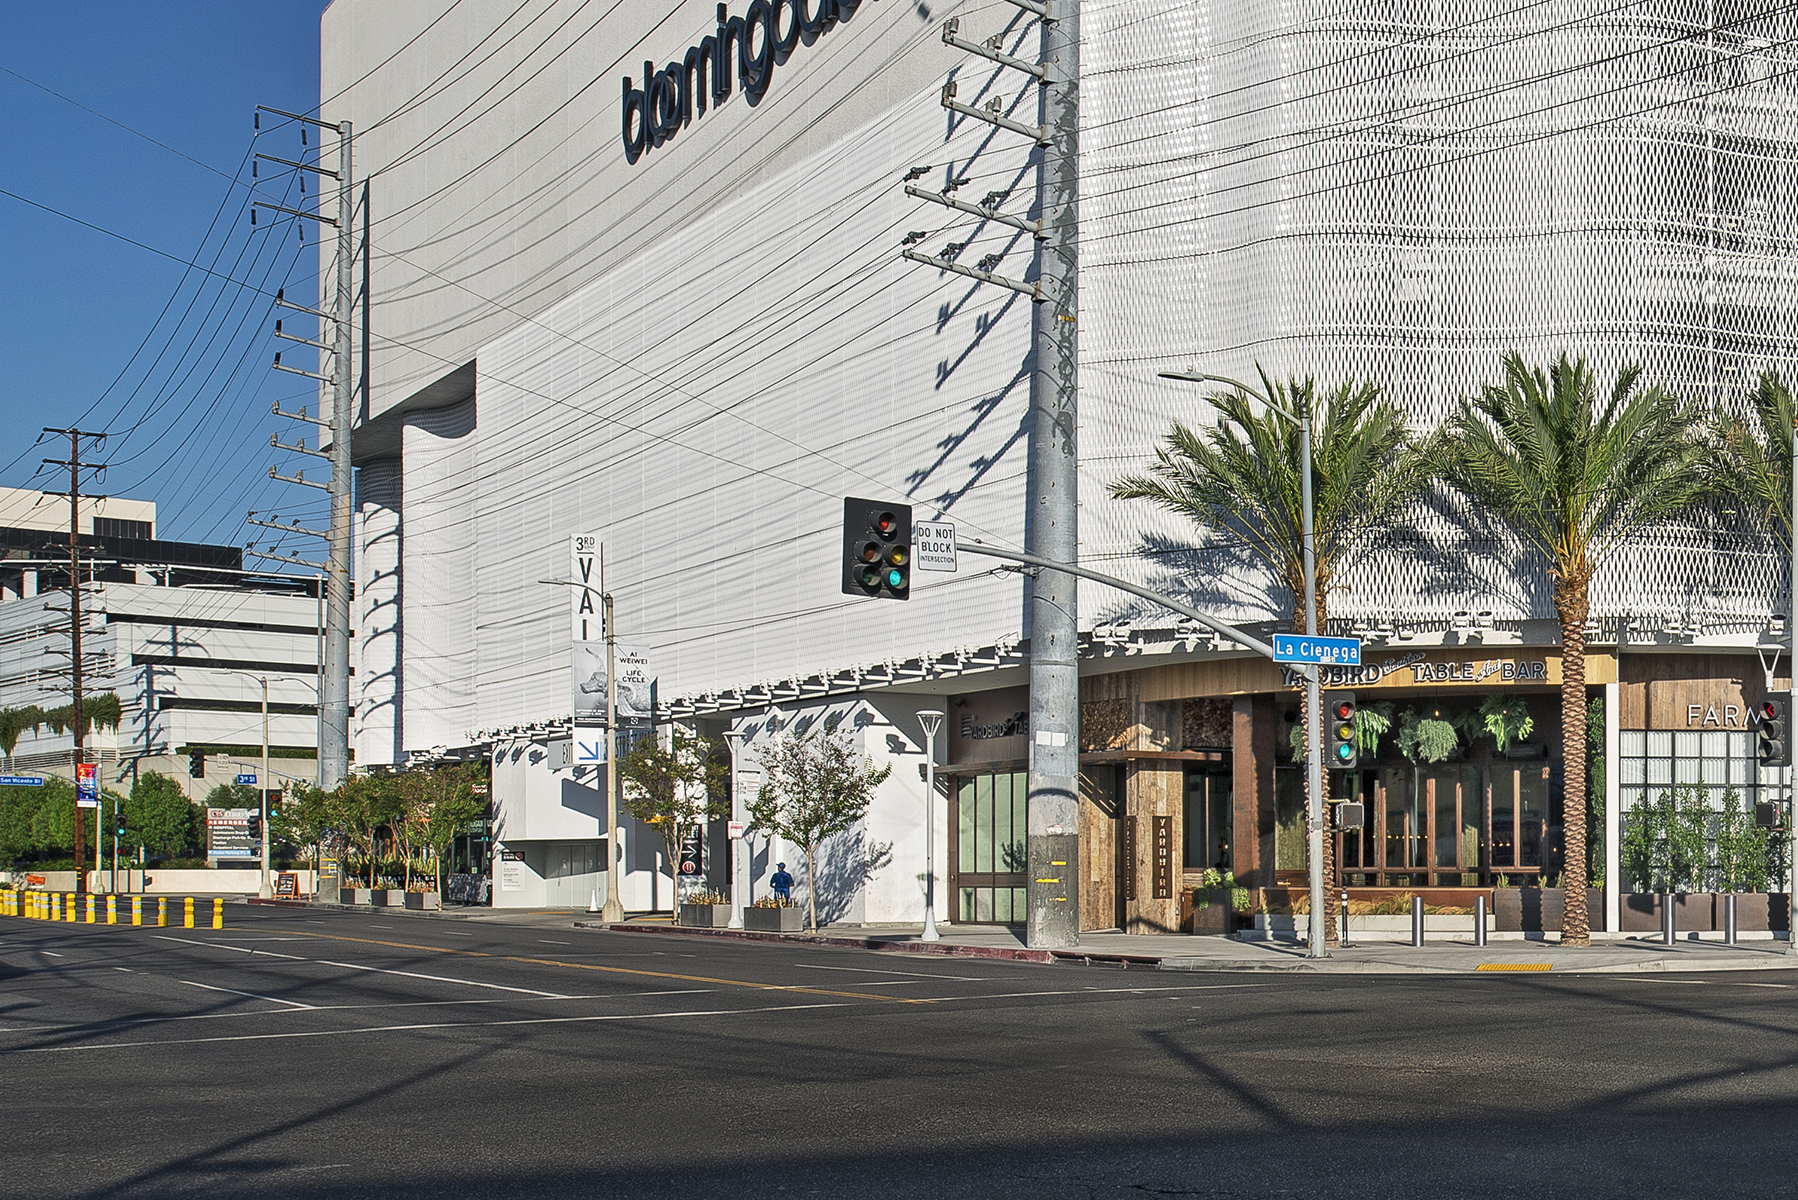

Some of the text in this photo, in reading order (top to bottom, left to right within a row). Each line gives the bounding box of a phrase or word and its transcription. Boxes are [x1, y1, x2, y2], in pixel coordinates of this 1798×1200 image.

[919, 527, 952, 539] DO NOT
[922, 541, 952, 553] BLOCK
[1276, 640, 1358, 659] La Cienega
[620, 657, 648, 665] WEIWEI
[1280, 664, 1382, 687] YABIRD
[1411, 662, 1476, 682] TABLE
[1501, 660, 1546, 681] BAR
[970, 724, 1005, 739] YARDBIRD
